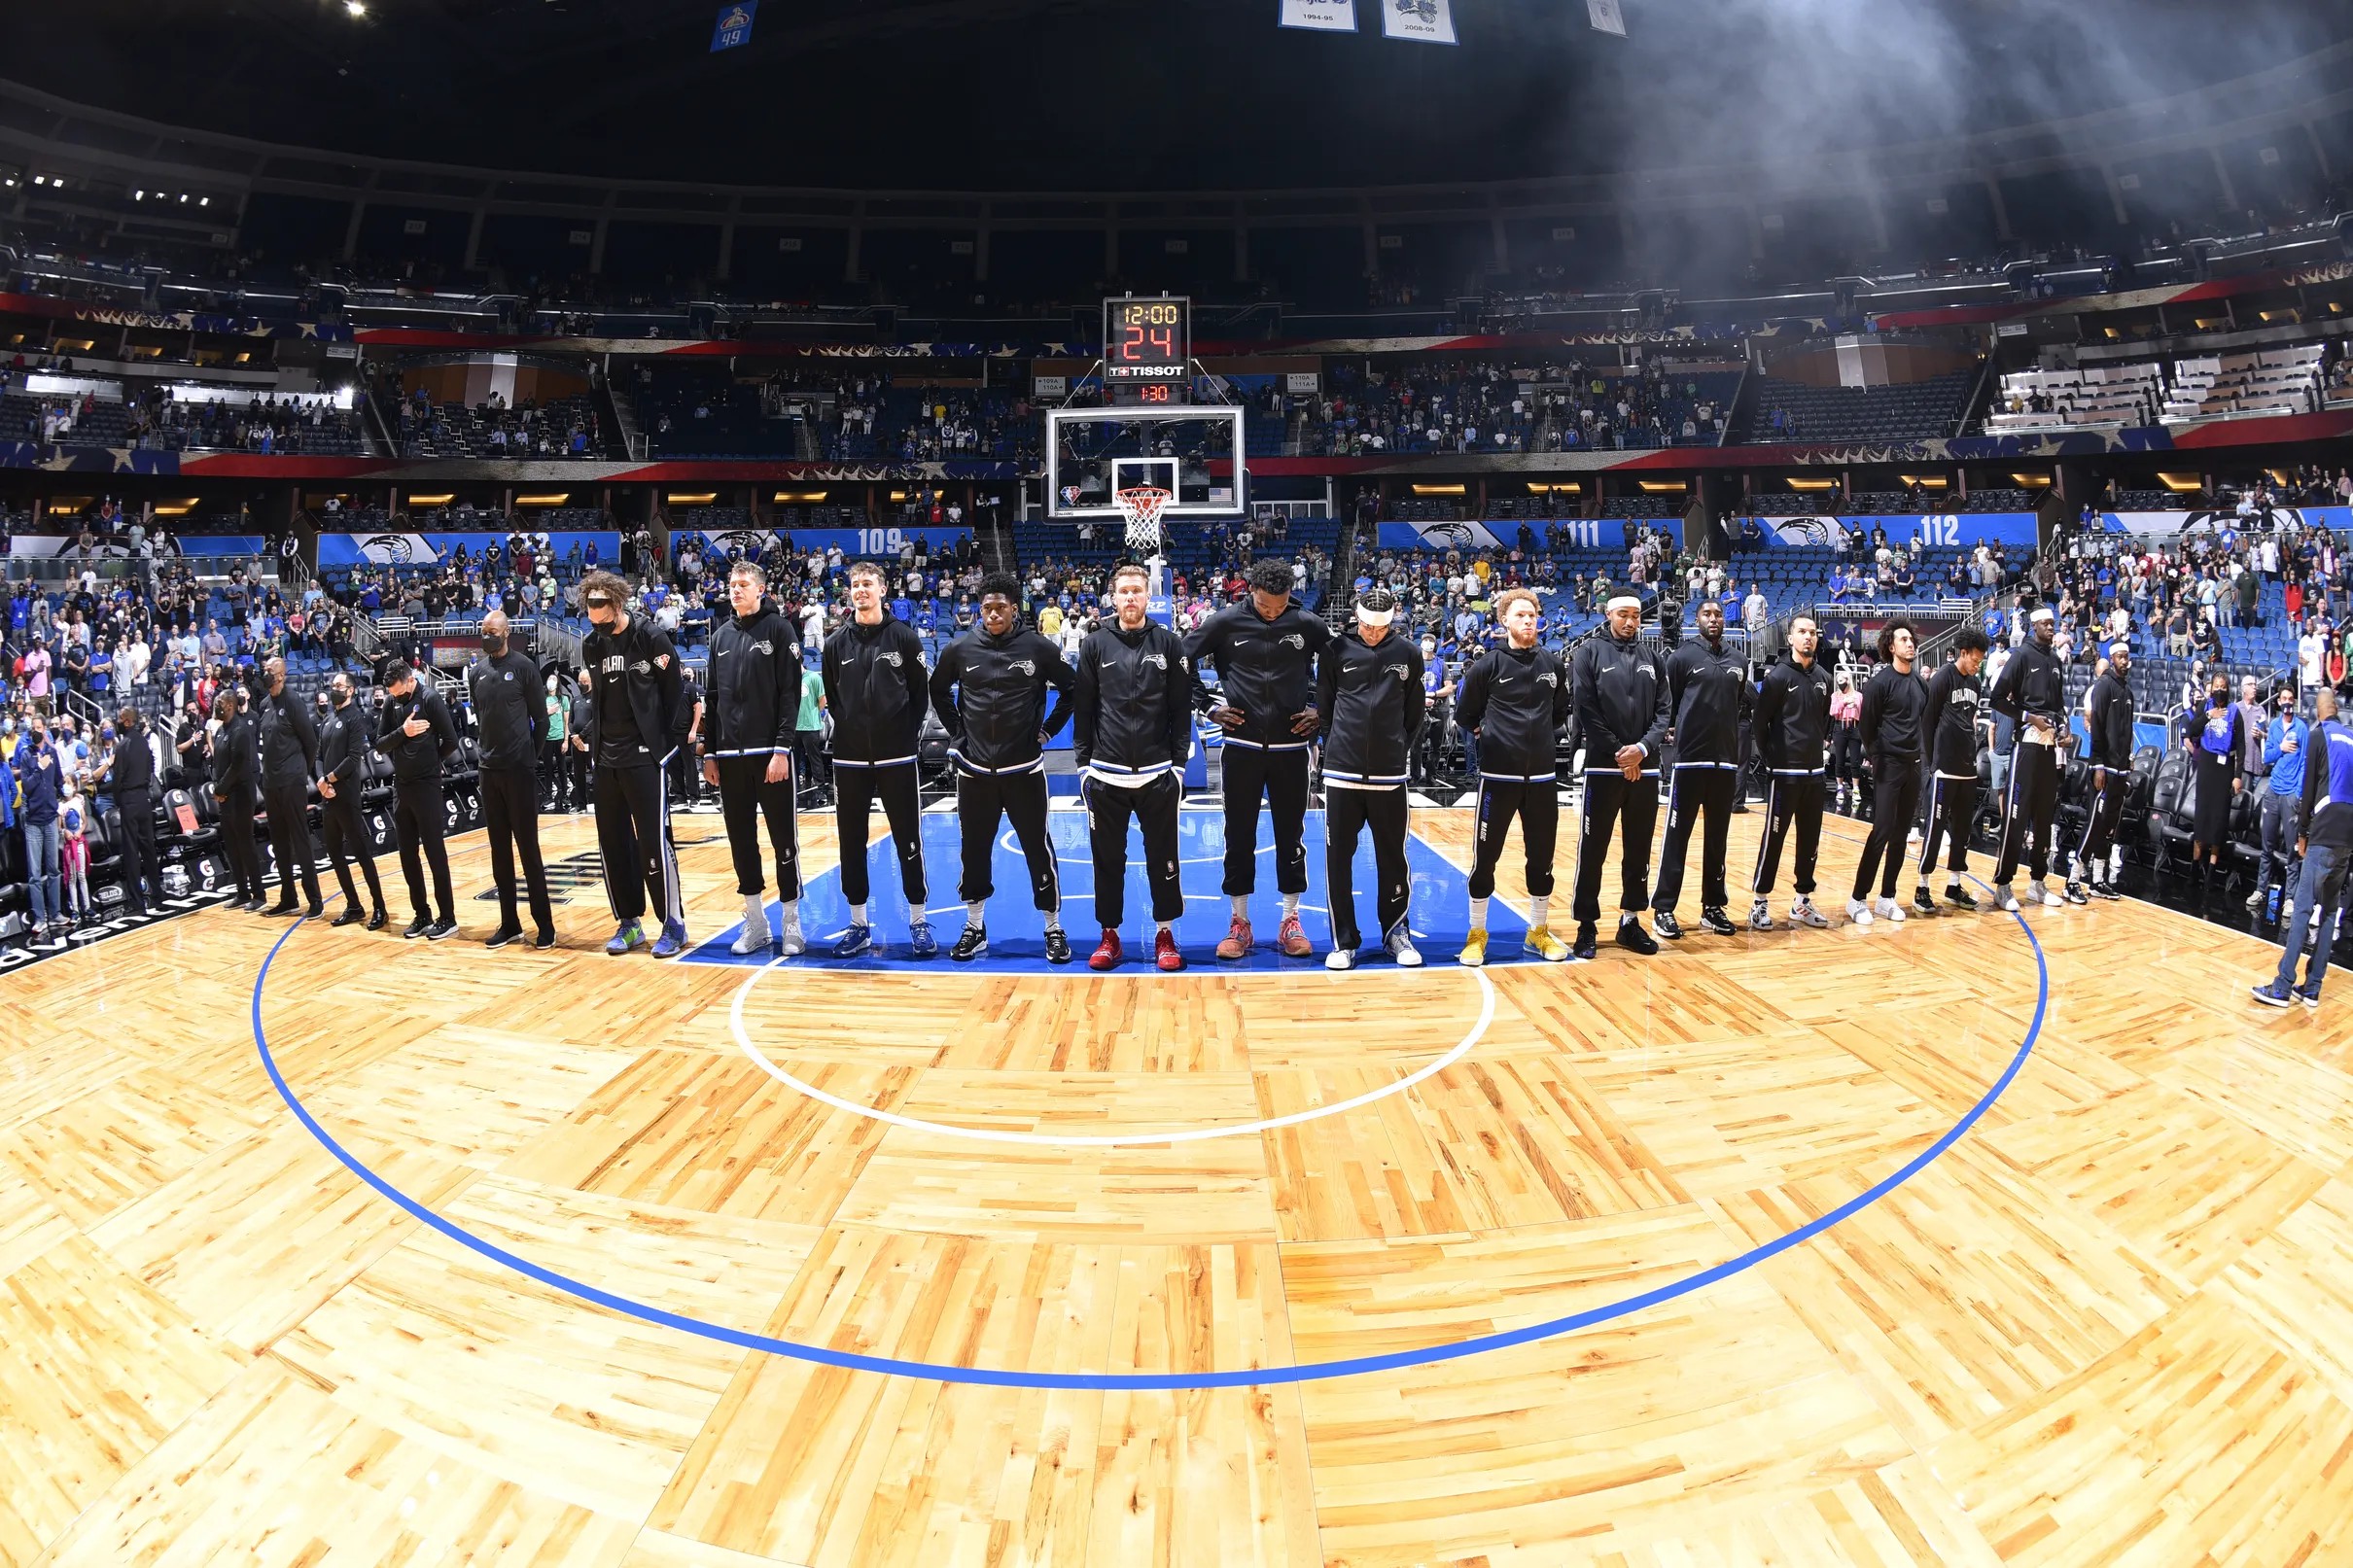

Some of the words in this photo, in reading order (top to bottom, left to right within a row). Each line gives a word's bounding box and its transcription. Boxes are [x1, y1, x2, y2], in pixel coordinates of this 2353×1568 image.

[1404, 24, 1435, 33] 2008-09
[721, 30, 741, 46] 49
[1125, 305, 1176, 324] 12:00
[1123, 327, 1171, 360] 24
[1130, 366, 1184, 376] TISSOT
[1141, 386, 1168, 401] 1:30
[1567, 520, 1599, 547] 111
[1920, 515, 1959, 545] 112
[859, 528, 901, 554] 109
[465, 738, 473, 748] G
[373, 750, 383, 761] G
[172, 790, 184, 803] G
[468, 795, 479, 809] G
[446, 799, 458, 814] G
[373, 815, 386, 830] G
[199, 859, 215, 876] G
